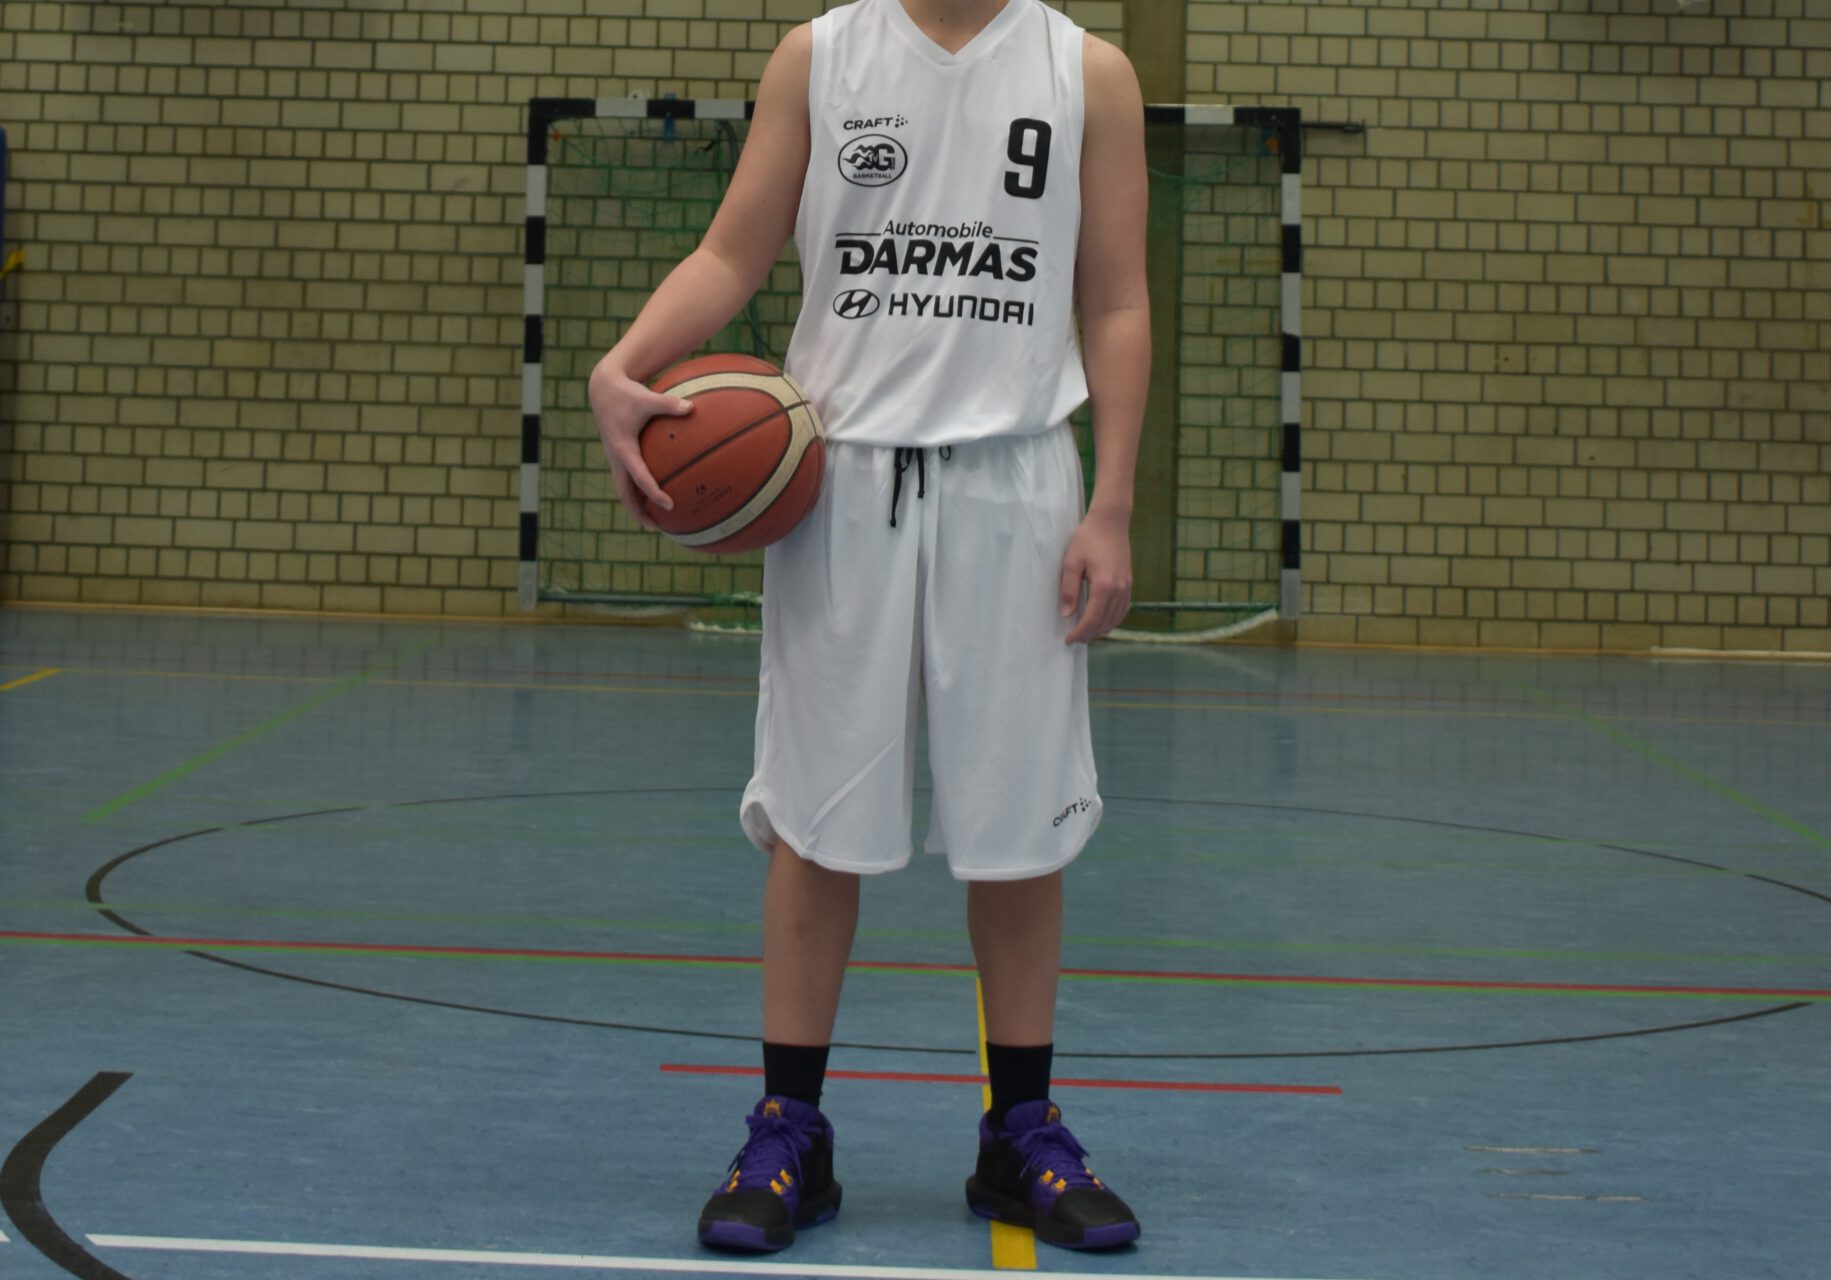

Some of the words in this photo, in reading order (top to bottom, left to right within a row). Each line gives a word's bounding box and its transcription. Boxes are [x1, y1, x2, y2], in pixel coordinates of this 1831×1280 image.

[843, 117, 893, 130] CRAFT
[1004, 117, 1052, 199] 9
[882, 220, 993, 238] Automobile
[835, 238, 1039, 282] DARMAS
[888, 293, 1035, 326] HYUNDAI
